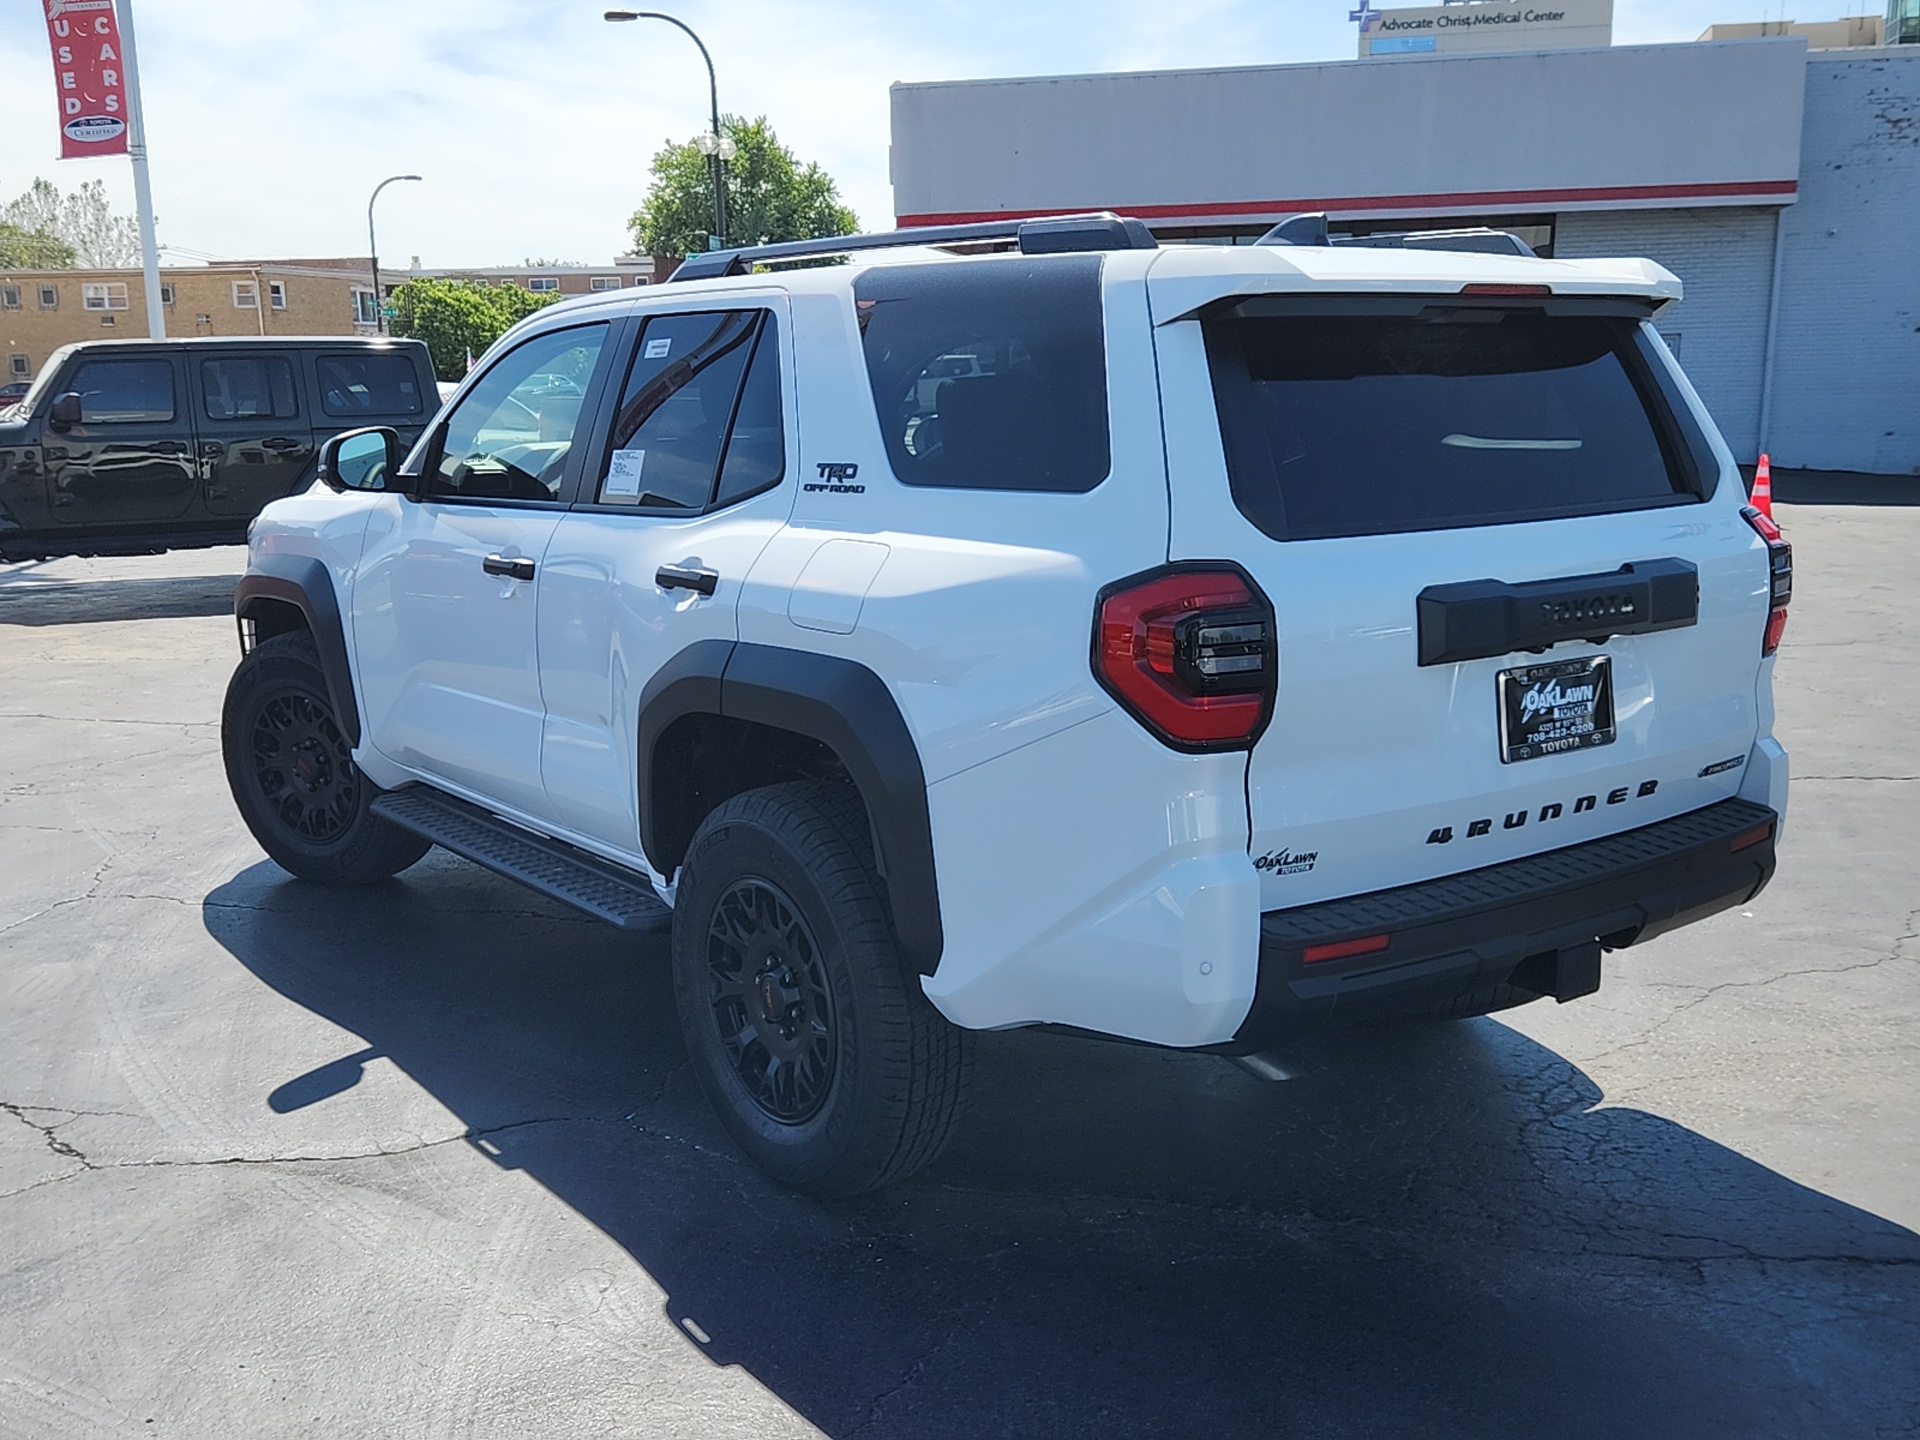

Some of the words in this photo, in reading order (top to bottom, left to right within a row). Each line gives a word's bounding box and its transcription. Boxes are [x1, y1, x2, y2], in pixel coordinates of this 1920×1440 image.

[1379, 18, 1433, 31] Advocate
[1437, 15, 1472, 27] Christ
[1473, 13, 1521, 25] Medical
[1524, 10, 1565, 22] Center
[54, 20, 81, 114] USED
[95, 17, 119, 112] CARS
[816, 463, 858, 483] TRD
[1540, 594, 1635, 627] TOYOTA
[1526, 723, 1594, 743] 708-423-5200
[1541, 737, 1581, 753] TOYOTA
